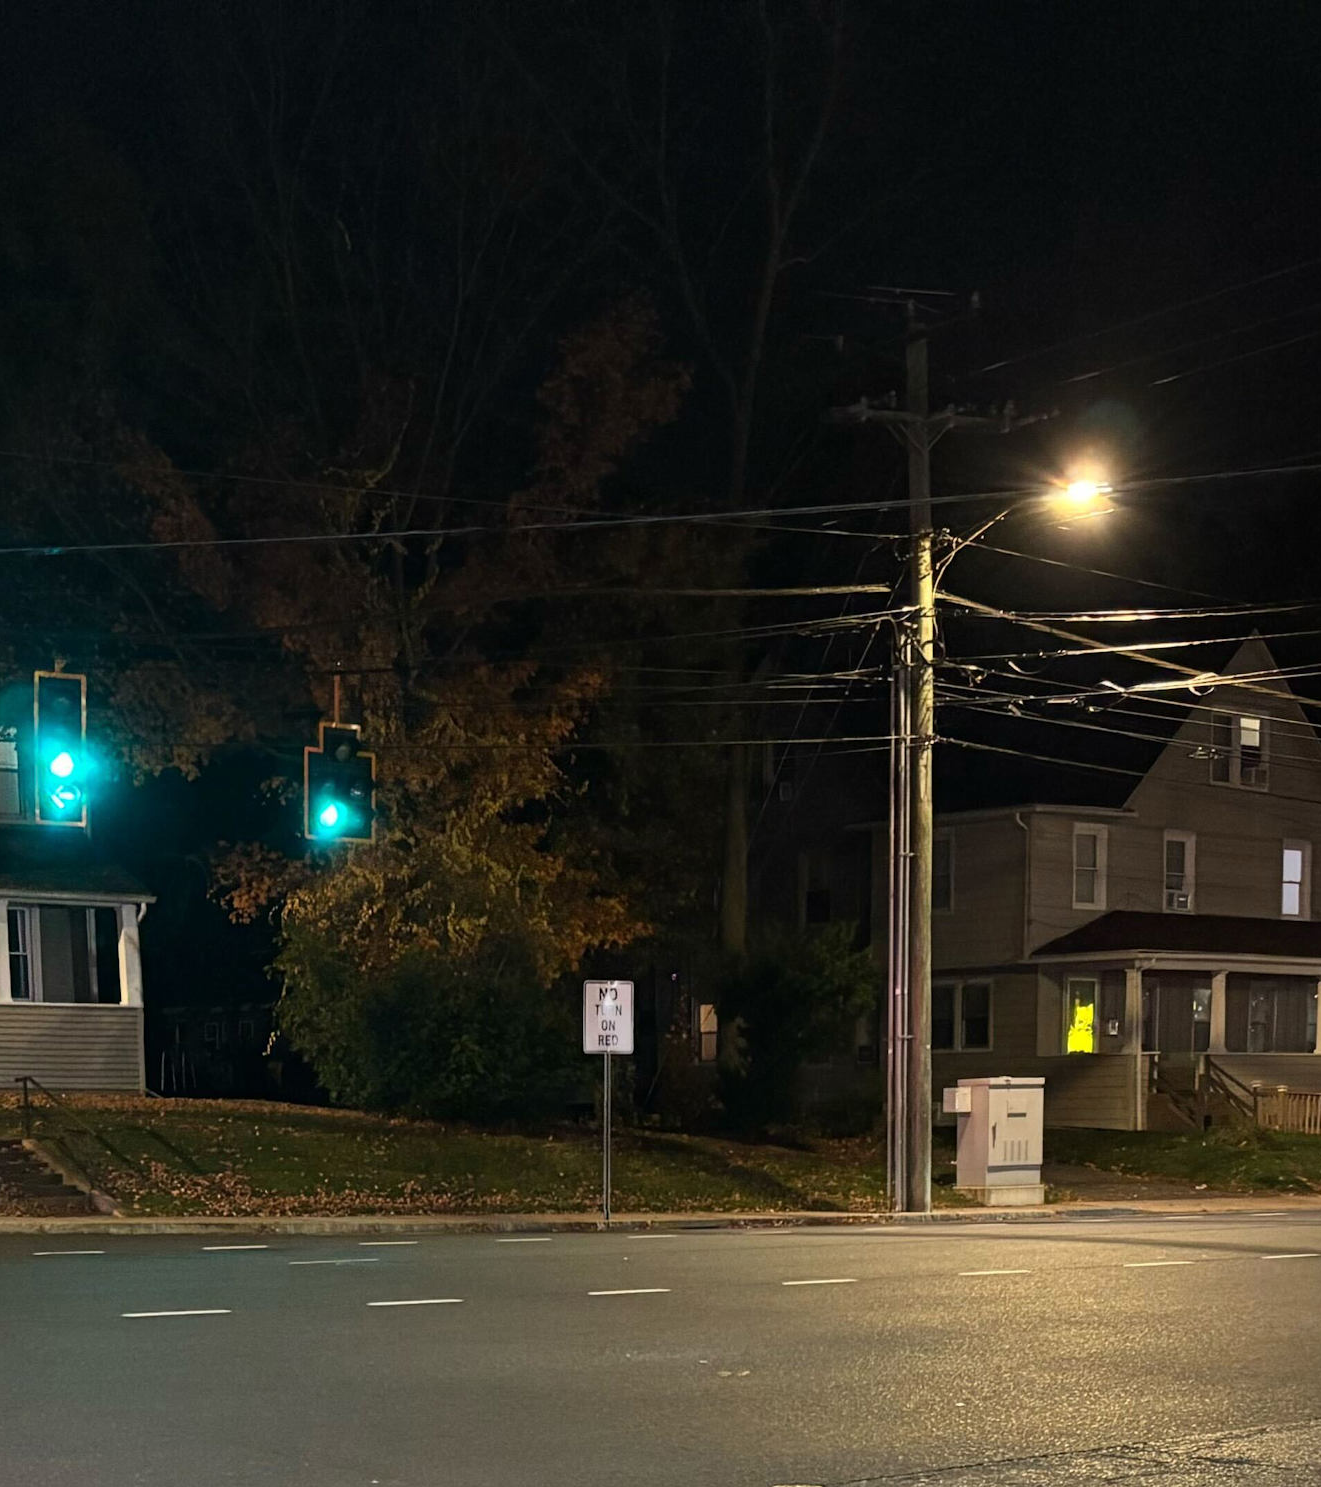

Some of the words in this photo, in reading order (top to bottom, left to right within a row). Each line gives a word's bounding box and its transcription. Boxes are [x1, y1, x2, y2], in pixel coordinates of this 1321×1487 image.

[599, 988, 618, 1001] NO
[595, 1004, 622, 1017] TN
[601, 1020, 616, 1031] ON
[598, 1034, 618, 1047] RED
